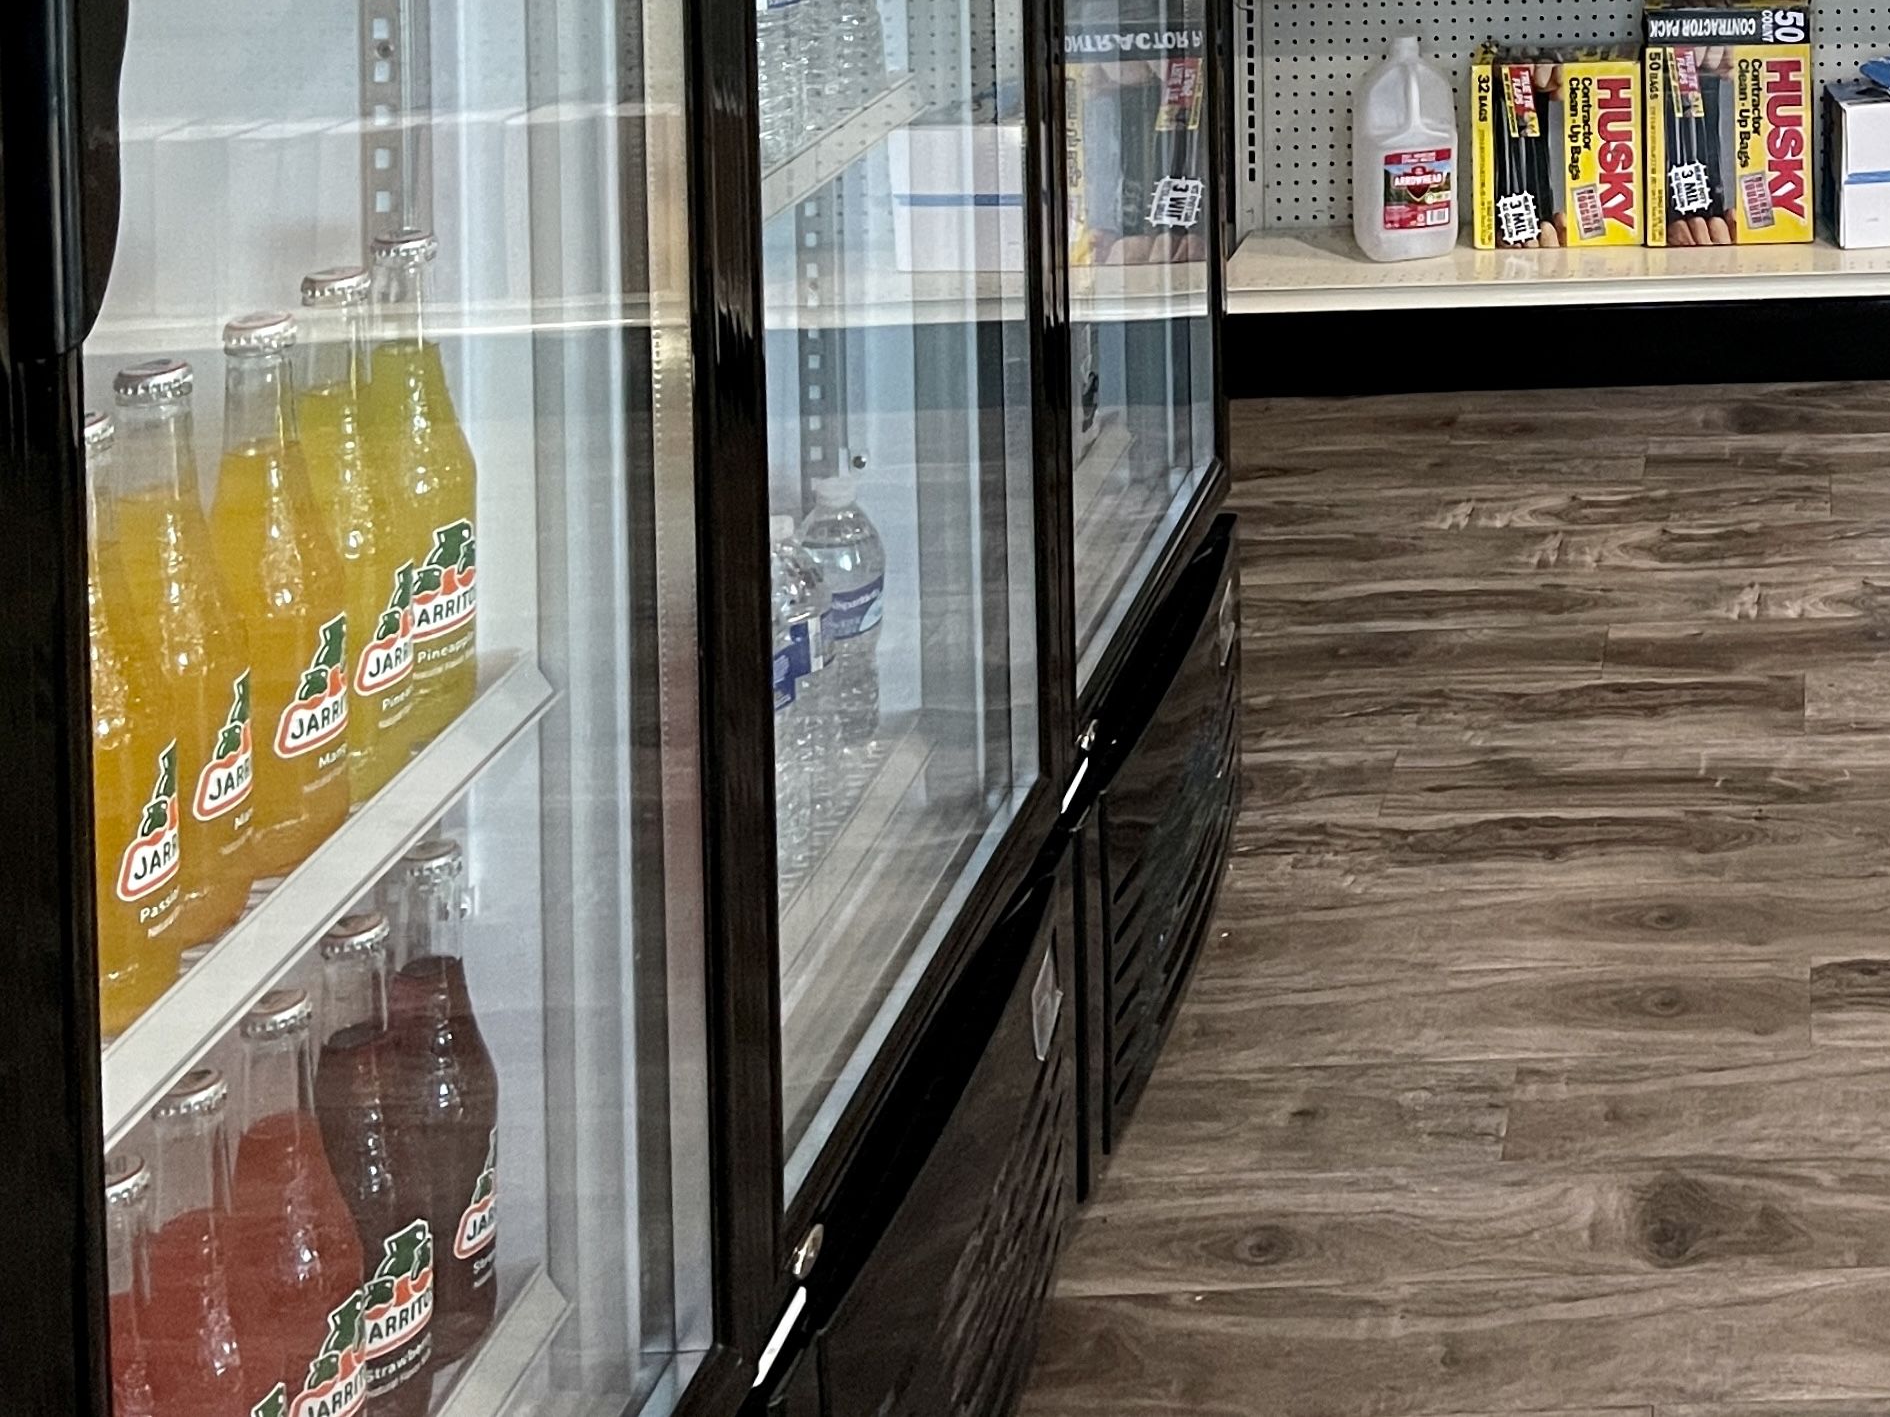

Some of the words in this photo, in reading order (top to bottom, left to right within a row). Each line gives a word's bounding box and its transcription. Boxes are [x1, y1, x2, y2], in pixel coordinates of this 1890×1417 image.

[1650, 19, 1685, 38] PACK
[1686, 17, 1757, 37] CONTRACTOR
[1774, 10, 1805, 43] 50
[1649, 51, 1661, 71] 50
[1478, 75, 1490, 94] 32
[1649, 73, 1660, 101] BAGS
[1751, 59, 1763, 136] Contractor
[1478, 95, 1488, 122] BAGS
[1581, 77, 1593, 151] Contractor
[1736, 131, 1751, 168] Bags
[1766, 60, 1805, 219] HUSKY
[1568, 146, 1582, 181] Bags
[1597, 78, 1635, 230] HUSKY
[1394, 173, 1443, 186] ARROWHEAD
[1681, 170, 1694, 179] 3
[1509, 200, 1519, 209] 3
[1684, 182, 1698, 207] MIL
[1511, 212, 1527, 236] MIL
